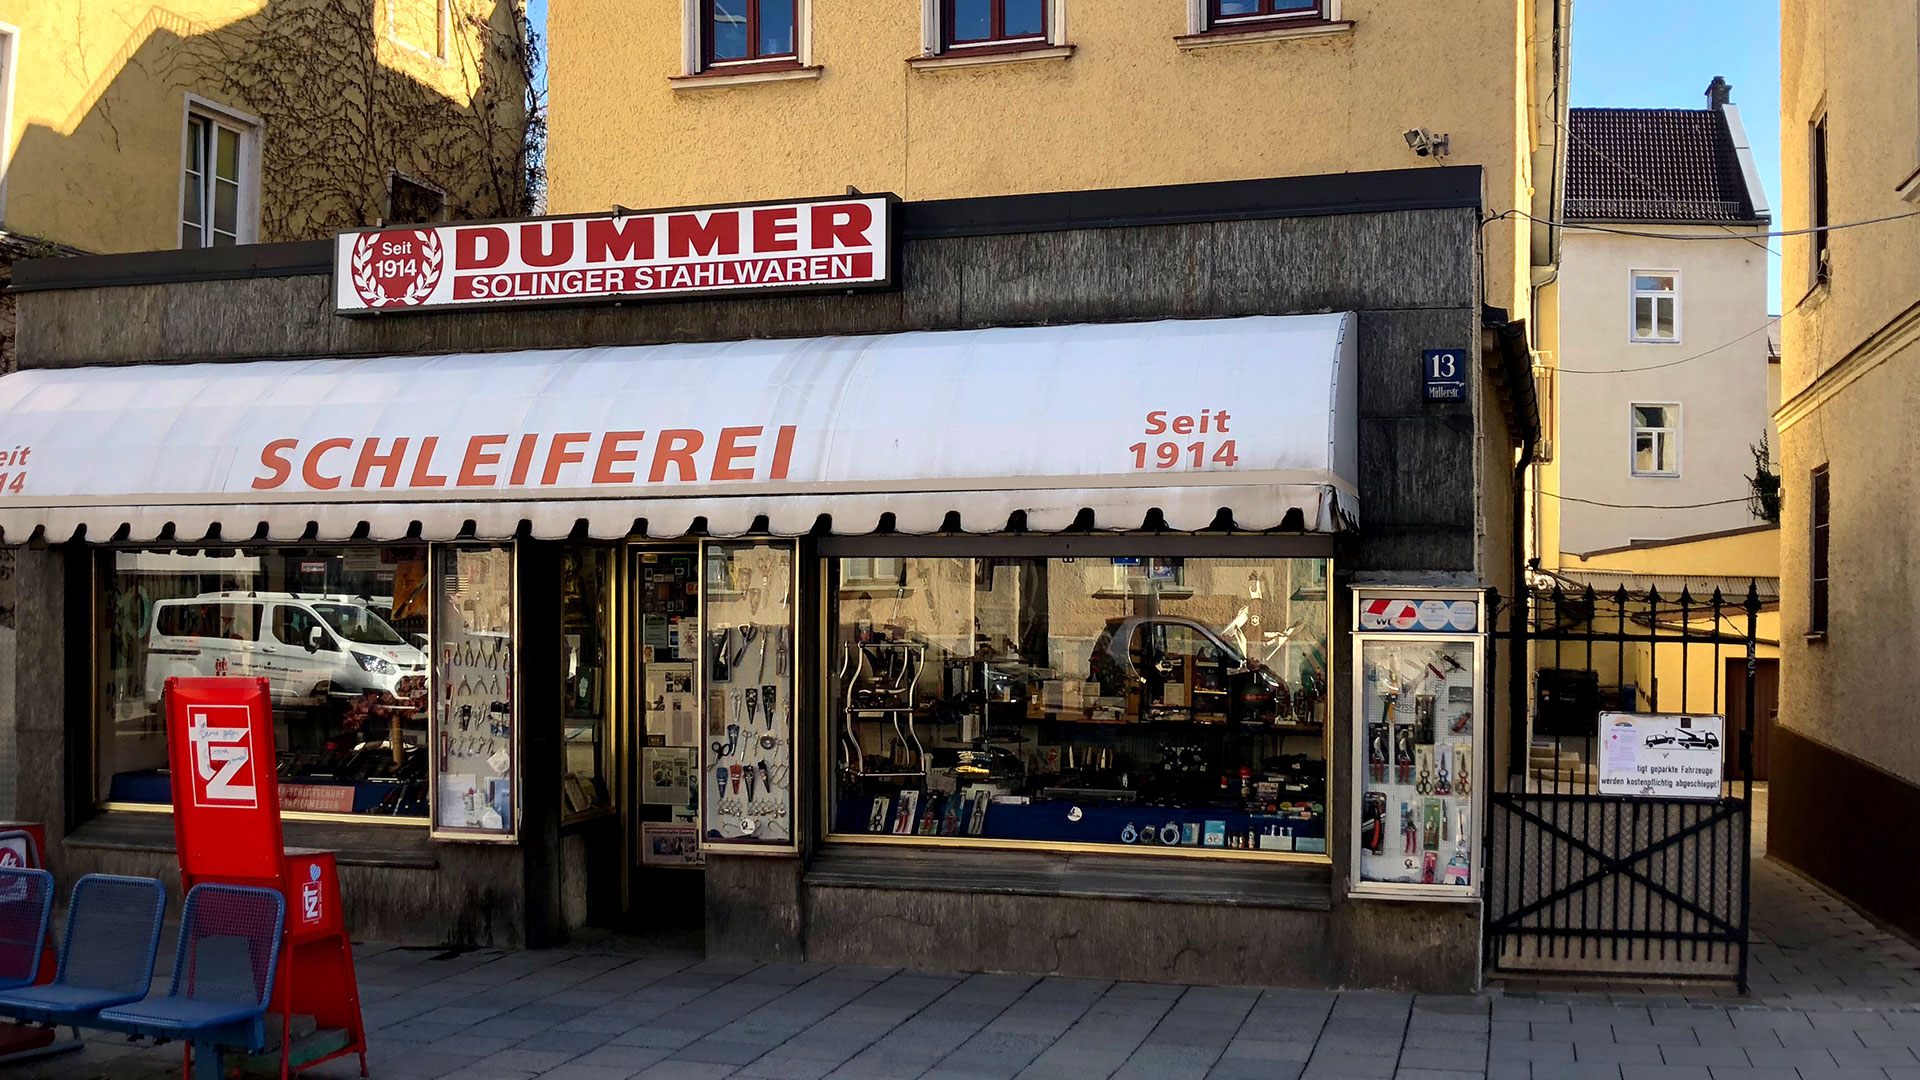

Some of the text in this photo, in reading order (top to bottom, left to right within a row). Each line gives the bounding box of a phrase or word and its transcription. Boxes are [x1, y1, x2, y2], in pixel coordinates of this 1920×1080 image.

[382, 241, 412, 256] Seit
[456, 203, 872, 270] DUMMER
[375, 259, 417, 279] 1914
[471, 255, 853, 298] SOLINGER STAHLWAREN
[1432, 354, 1456, 378] 13
[1145, 409, 1231, 435] Seit
[251, 425, 797, 490] SCHLEIFEREI
[1129, 440, 1239, 469] 1914
[1601, 777, 1720, 790] werden kostenpflichtig abgeschleppt!
[1637, 765, 1714, 777] tigt geparkte Fahrzeuge
